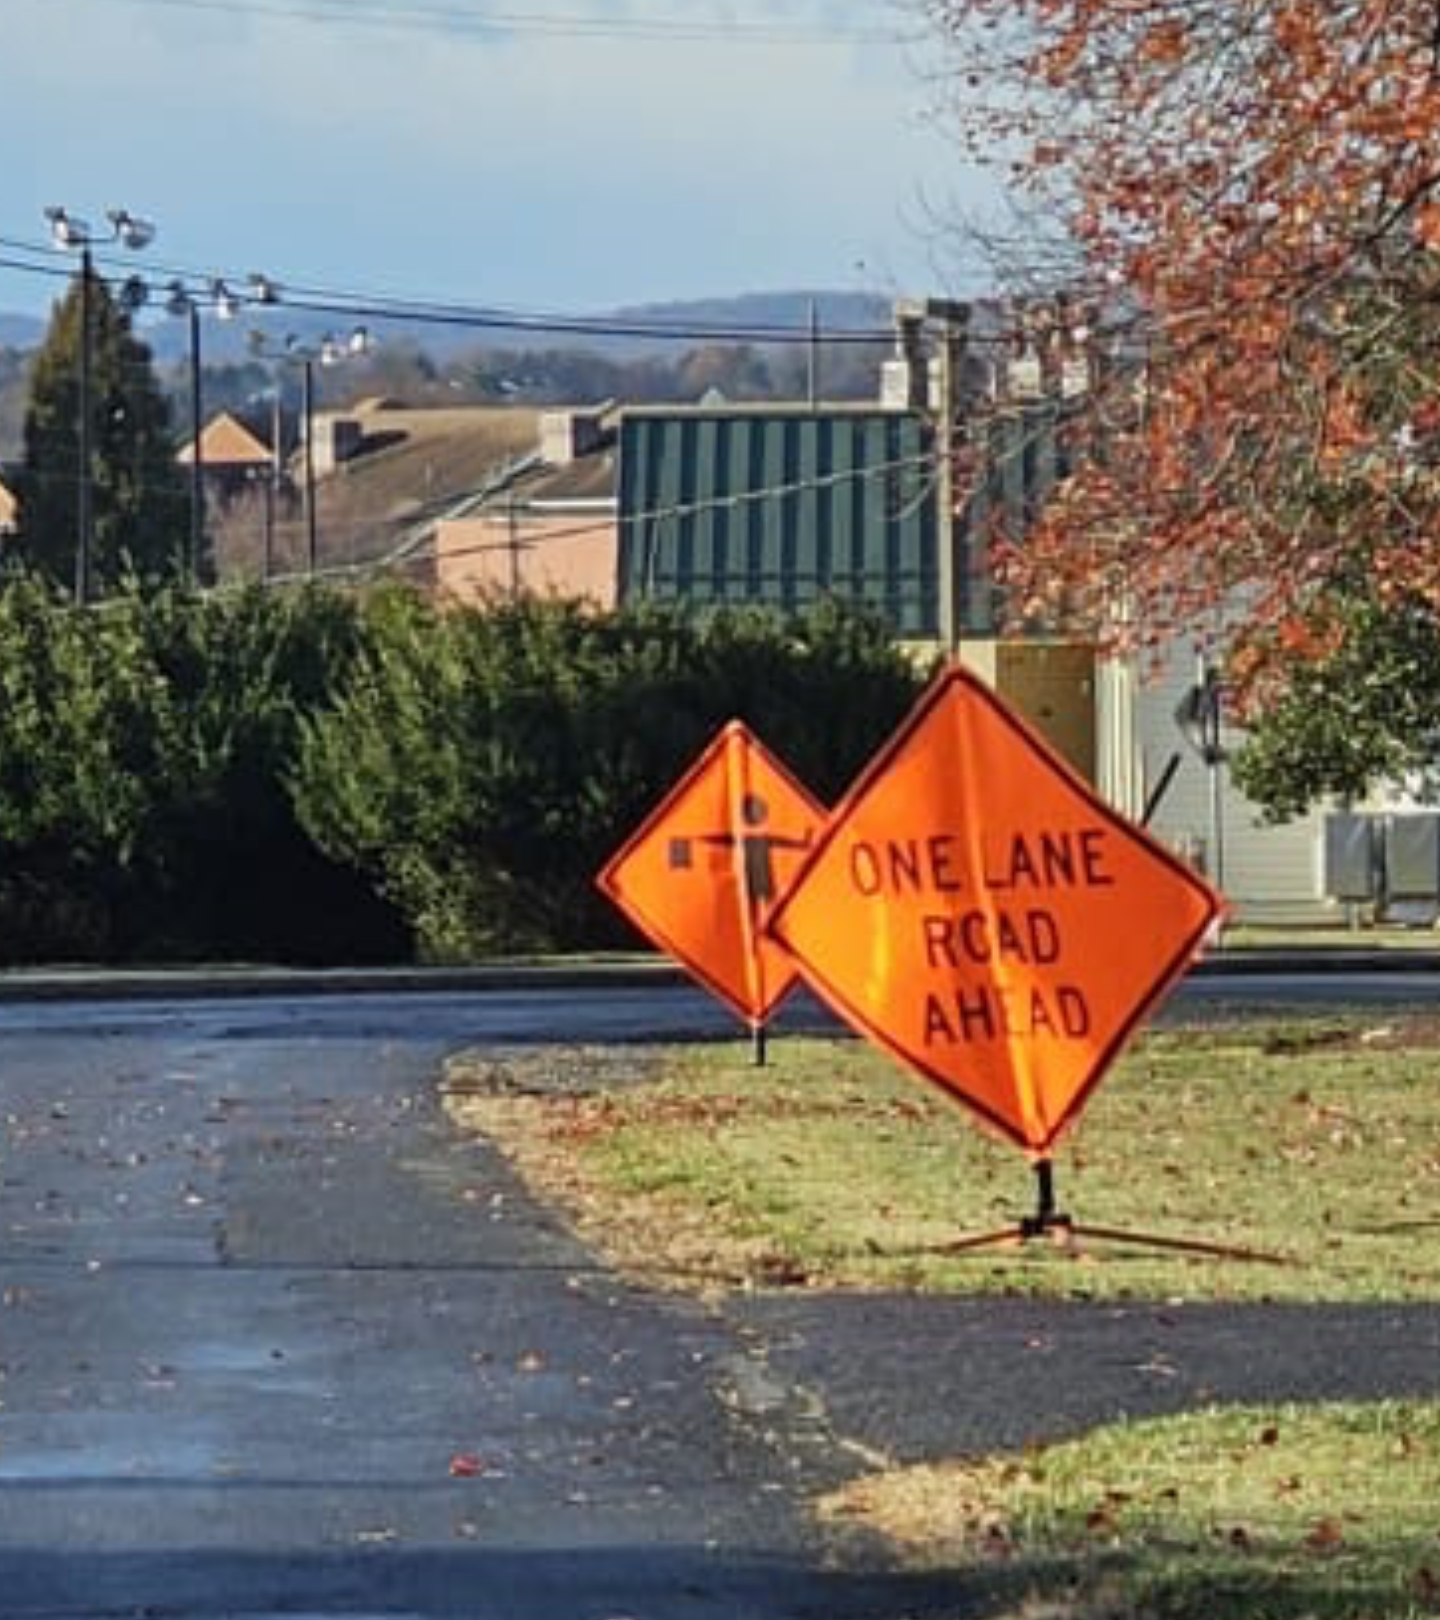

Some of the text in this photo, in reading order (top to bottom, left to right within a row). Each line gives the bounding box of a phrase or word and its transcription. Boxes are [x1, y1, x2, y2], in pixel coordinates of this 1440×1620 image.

[851, 829, 1115, 896] ONE LANE
[923, 909, 1061, 968] ROAD
[924, 984, 1091, 1046] AHEAD
